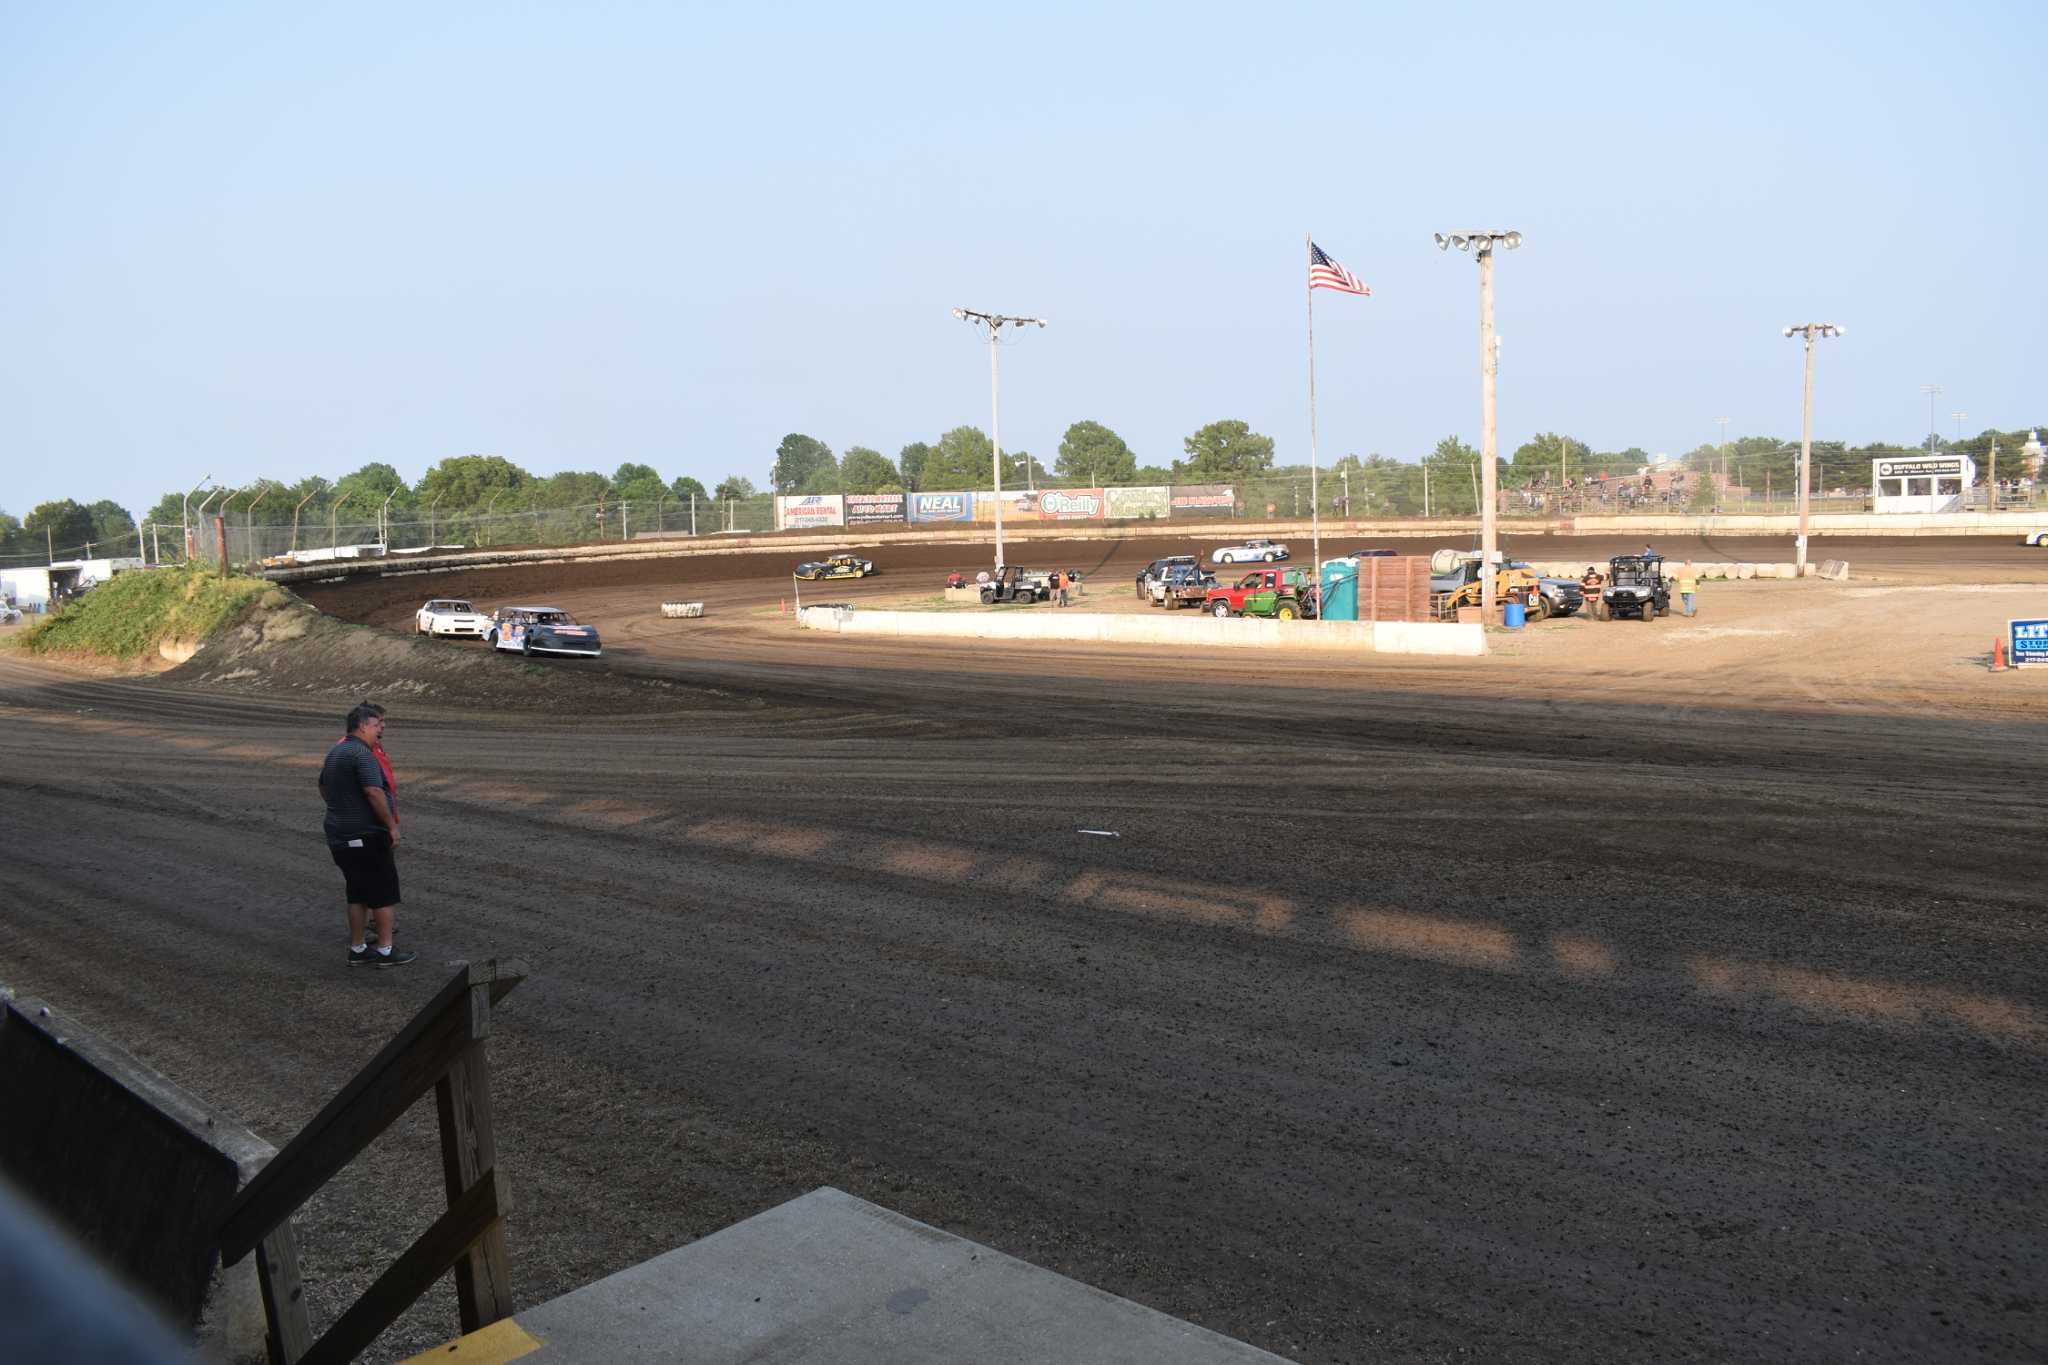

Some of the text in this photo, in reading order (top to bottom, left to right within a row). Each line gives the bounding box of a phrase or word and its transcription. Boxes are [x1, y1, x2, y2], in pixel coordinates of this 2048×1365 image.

[1893, 463, 1921, 471] BUFFALO
[1939, 461, 1960, 469] WINGS
[920, 496, 960, 509] NEAL
[1042, 491, 1099, 515] O'Reilly
